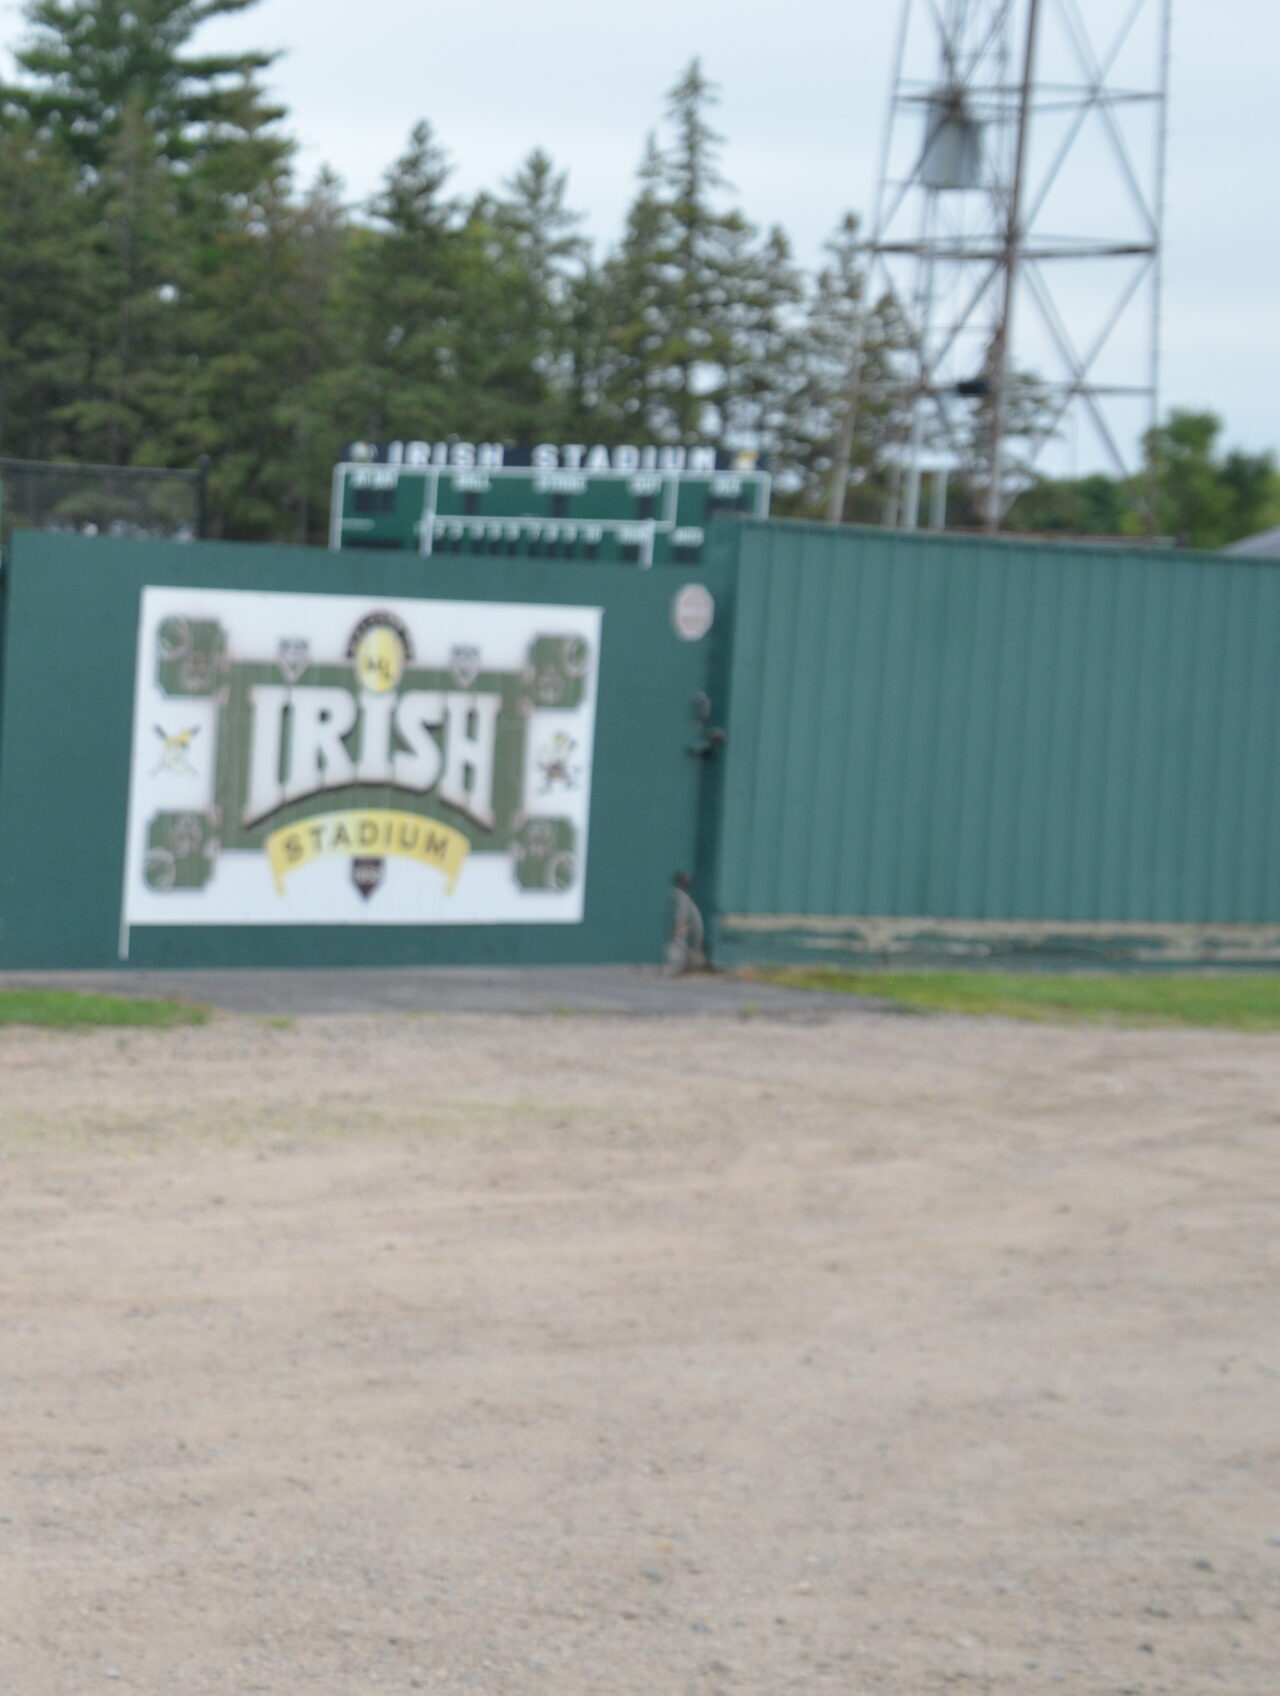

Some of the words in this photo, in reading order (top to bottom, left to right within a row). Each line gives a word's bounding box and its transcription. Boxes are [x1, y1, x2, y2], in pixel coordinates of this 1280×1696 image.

[388, 440, 504, 468] IRISH
[531, 443, 716, 472] STADIUM
[244, 685, 501, 831] IRISH
[283, 820, 449, 864] STADIUM
